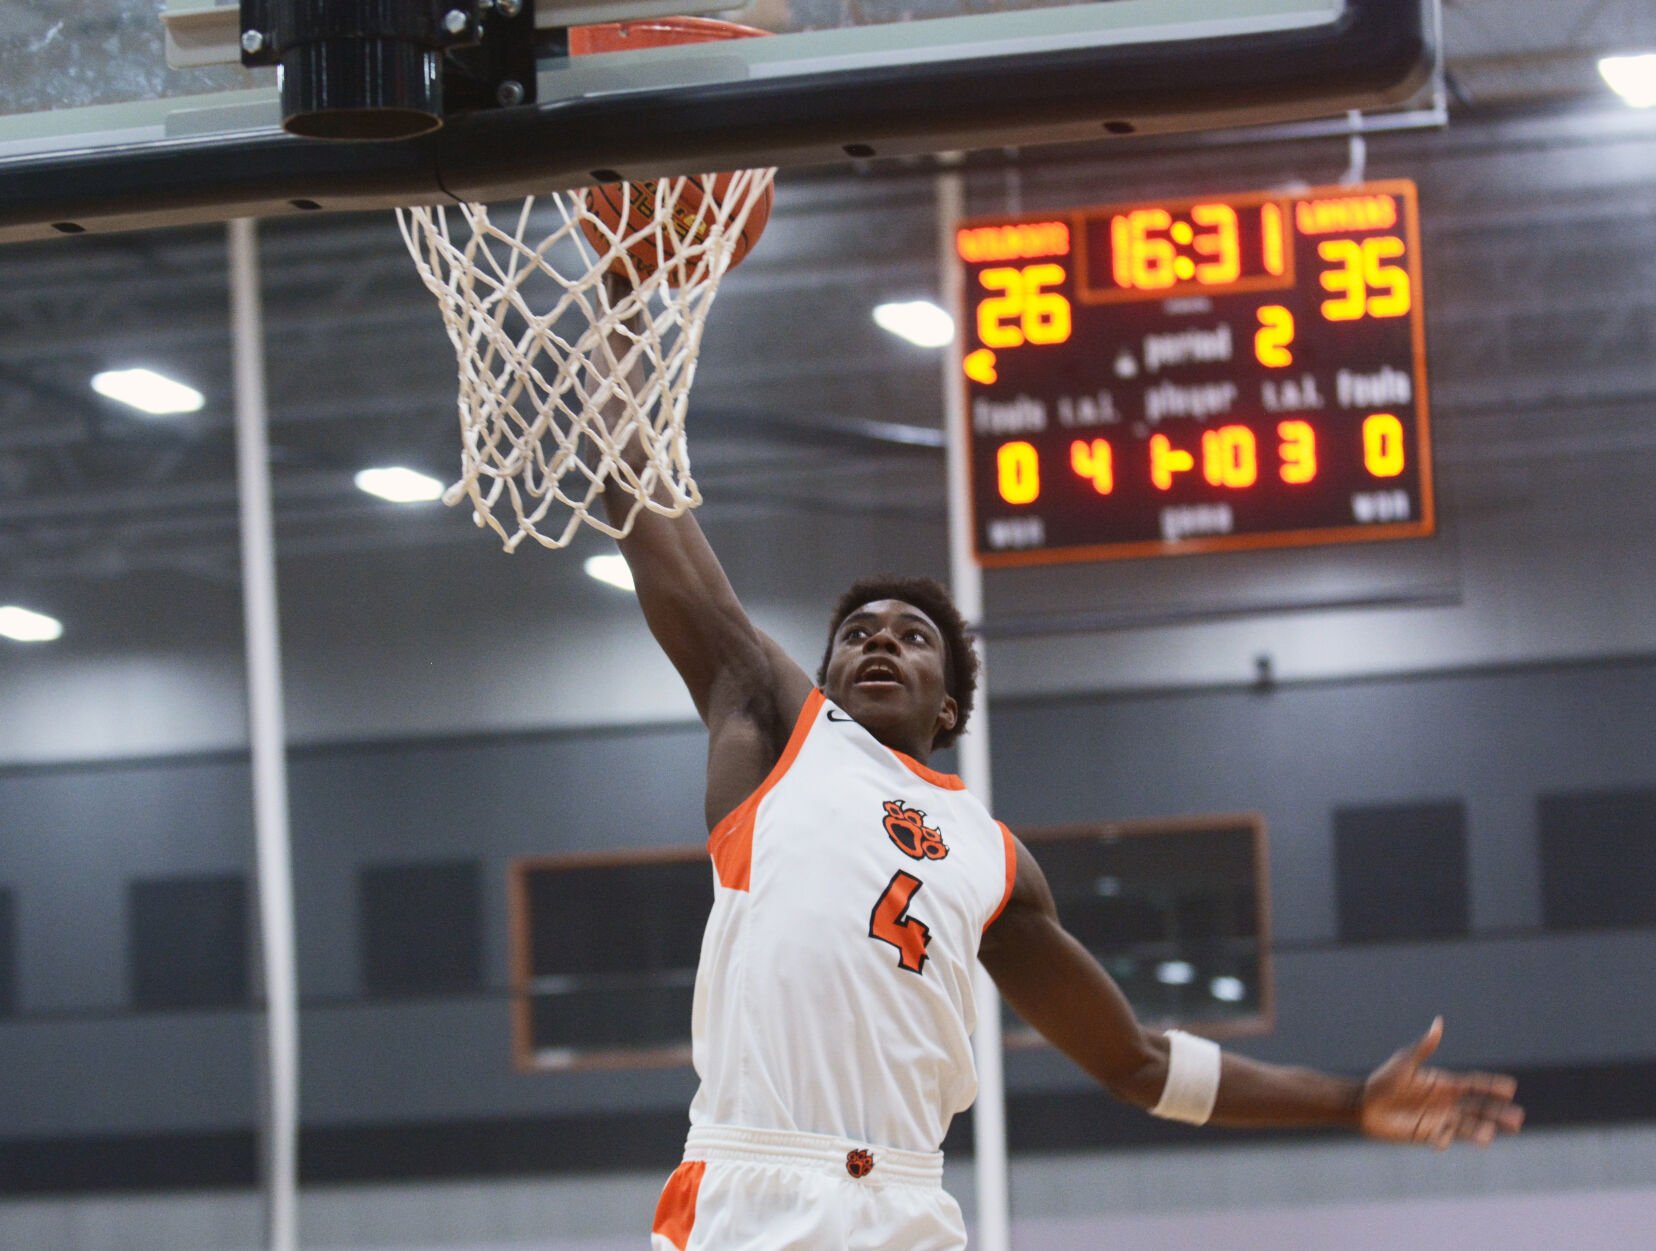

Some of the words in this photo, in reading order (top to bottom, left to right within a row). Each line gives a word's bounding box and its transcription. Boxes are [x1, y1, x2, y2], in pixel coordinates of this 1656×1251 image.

[1111, 203, 1284, 290] 16:31
[1317, 235, 1411, 322] 35
[977, 263, 1071, 348] 26
[1254, 304, 1295, 368] 2
[997, 441, 1040, 505] 0
[1070, 438, 1114, 496] 4
[1277, 420, 1317, 484] 3
[1362, 413, 1405, 478] 0
[868, 868, 932, 976] 4
